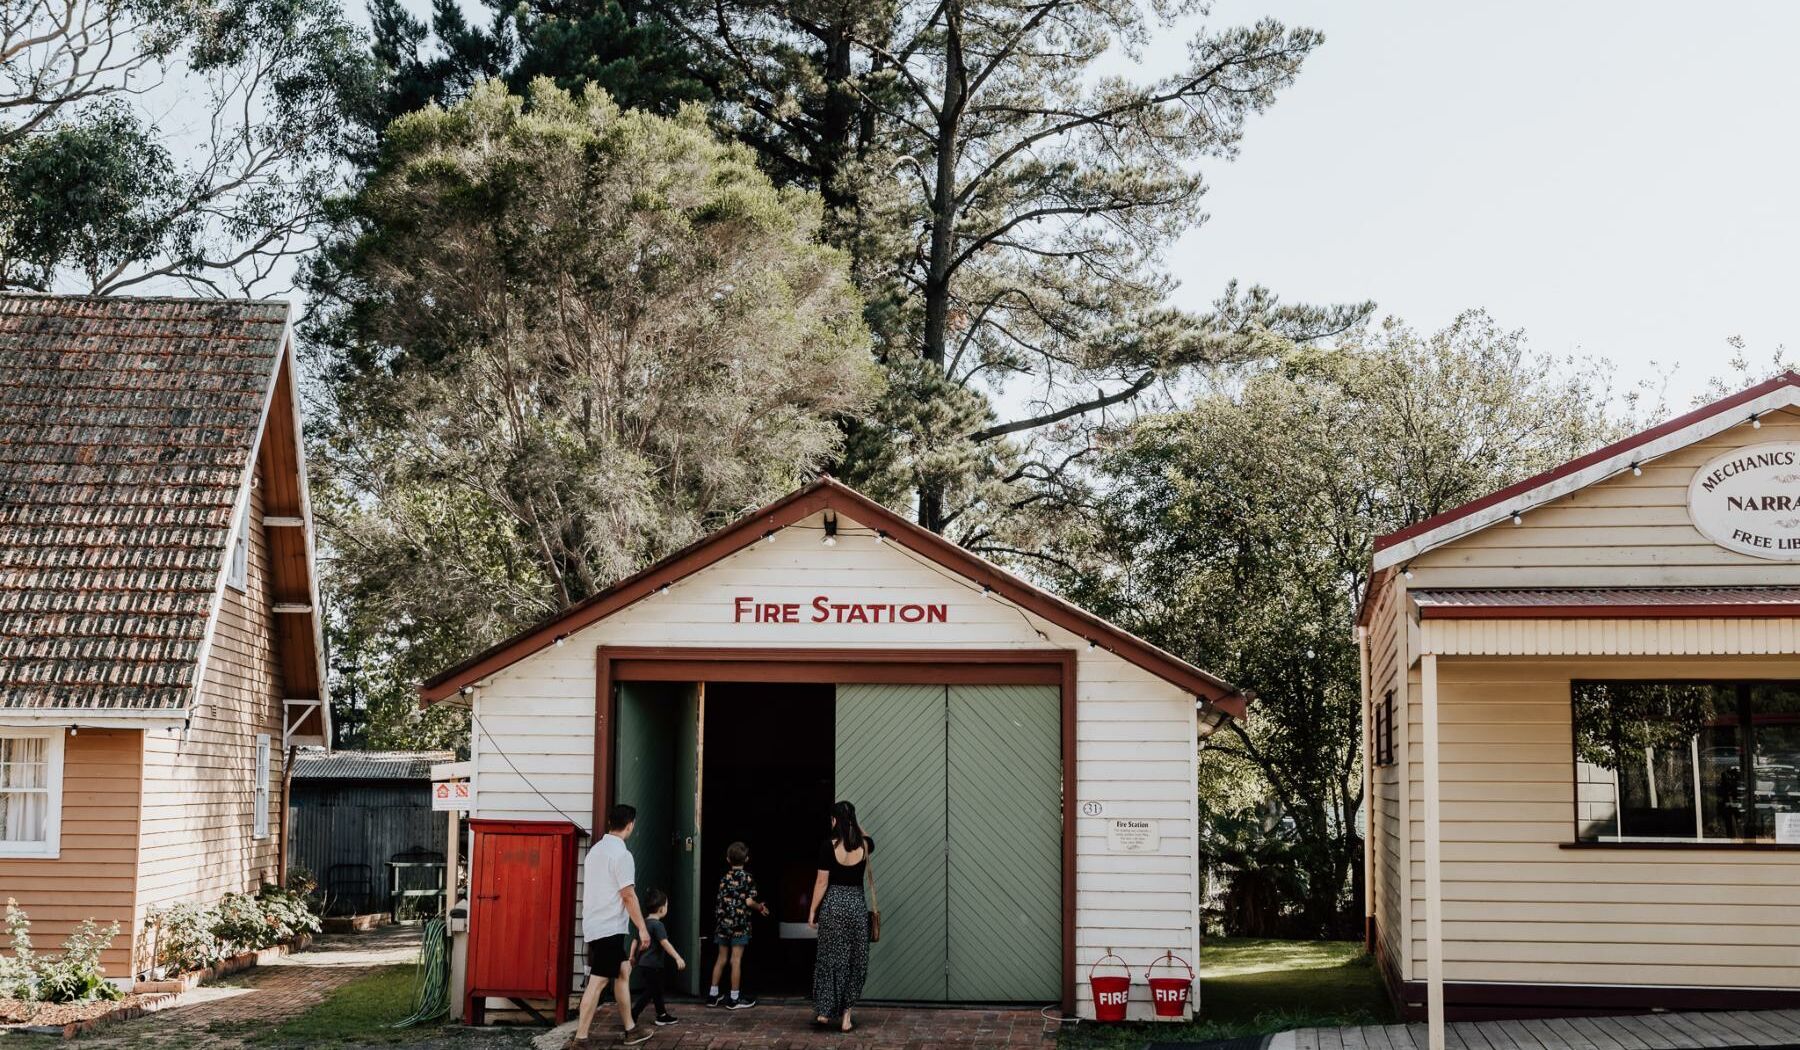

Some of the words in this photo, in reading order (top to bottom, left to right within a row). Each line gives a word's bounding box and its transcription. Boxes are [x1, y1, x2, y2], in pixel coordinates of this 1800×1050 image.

[1702, 452, 1796, 493] MECHANICS'
[1732, 529, 1772, 548] FREE
[1778, 538, 1800, 550] LIB
[735, 597, 800, 623] FIRE
[811, 596, 948, 623] STATION
[1088, 803, 1098, 814] 31
[1128, 820, 1149, 828] Station
[1099, 991, 1128, 1005] FIRE
[1155, 988, 1186, 1002] FIRE
